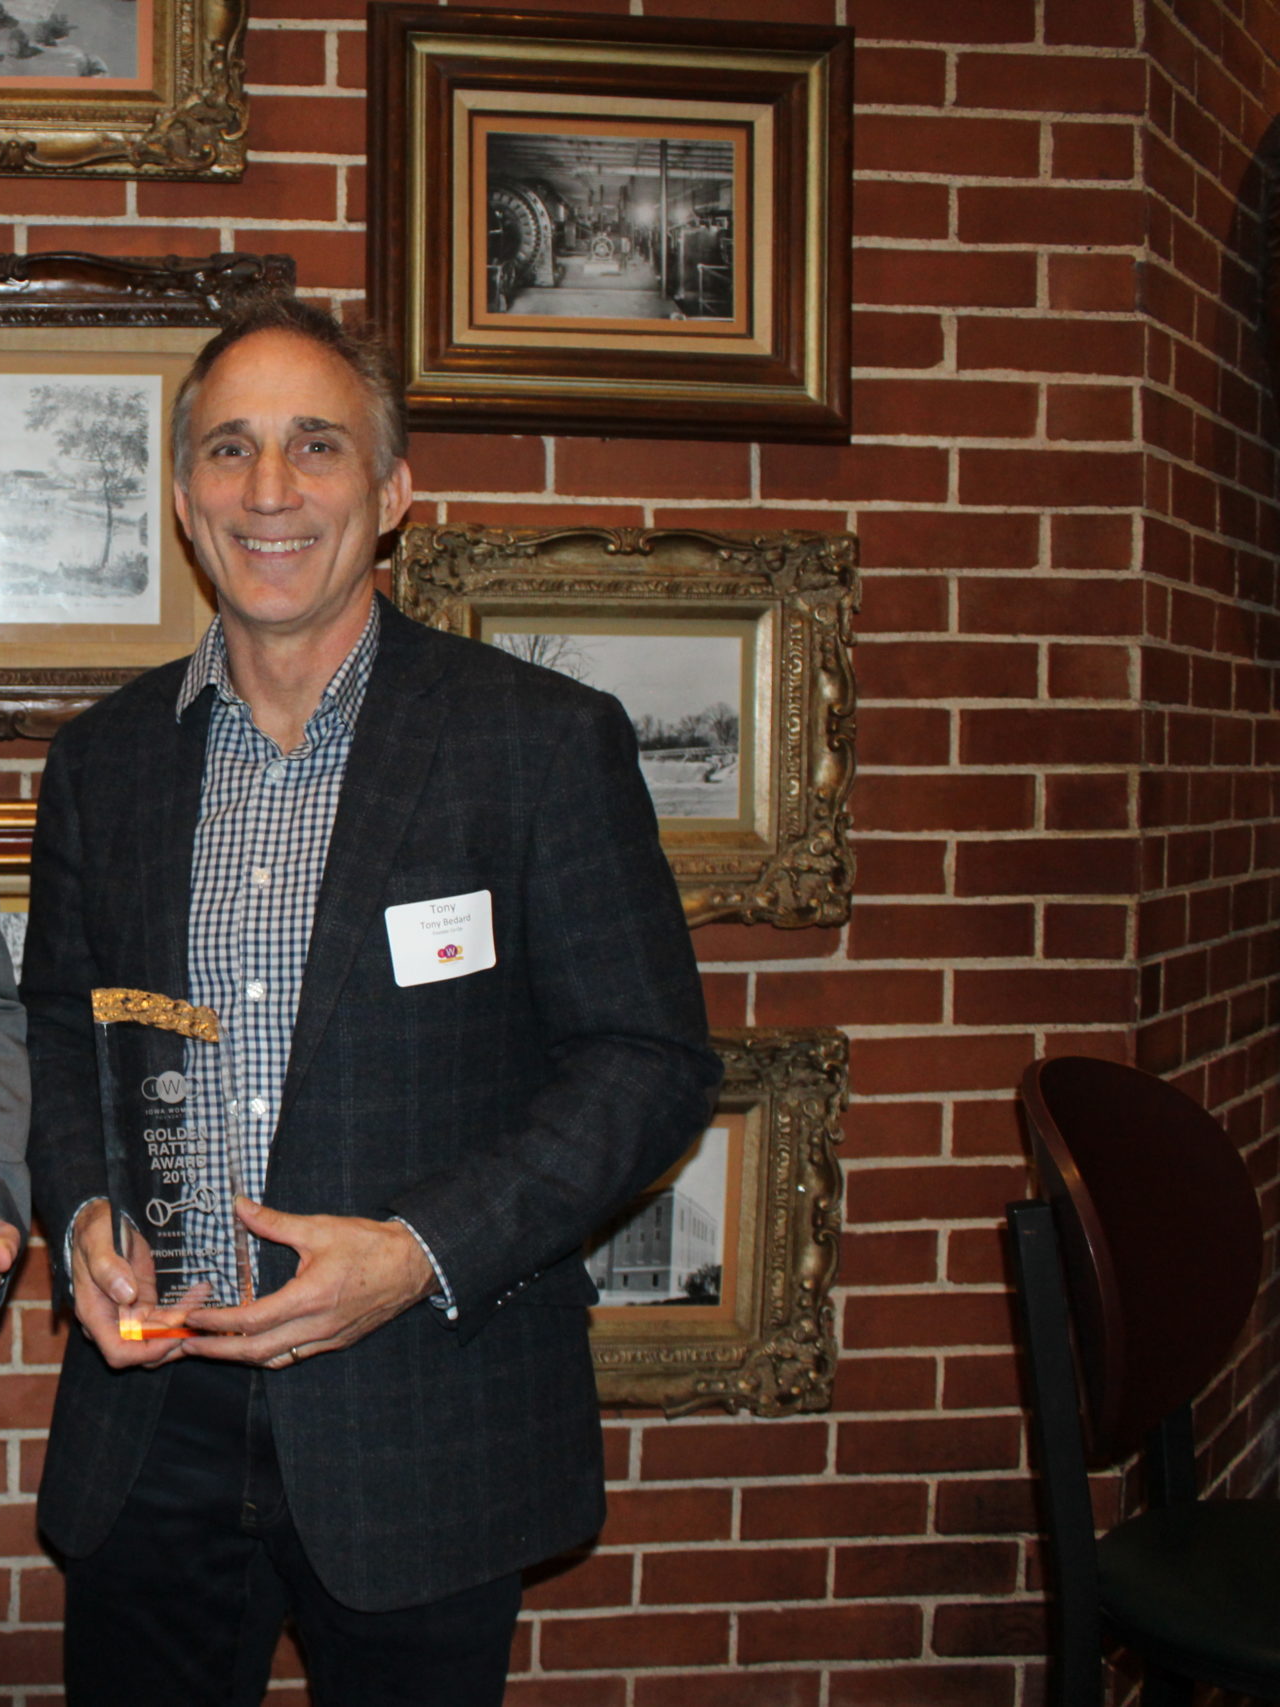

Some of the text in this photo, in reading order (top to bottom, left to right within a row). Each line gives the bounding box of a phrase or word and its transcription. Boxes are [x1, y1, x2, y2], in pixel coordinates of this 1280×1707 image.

[429, 903, 457, 914] Tony
[420, 920, 441, 931] Tony
[443, 914, 472, 927] Bedard
[143, 1126, 208, 1142] GOLDEN
[148, 1140, 208, 1156] RATTLE
[150, 1155, 208, 1171] AWARD
[162, 1168, 197, 1184] 2019
[150, 1249, 193, 1258] FRONTIER
